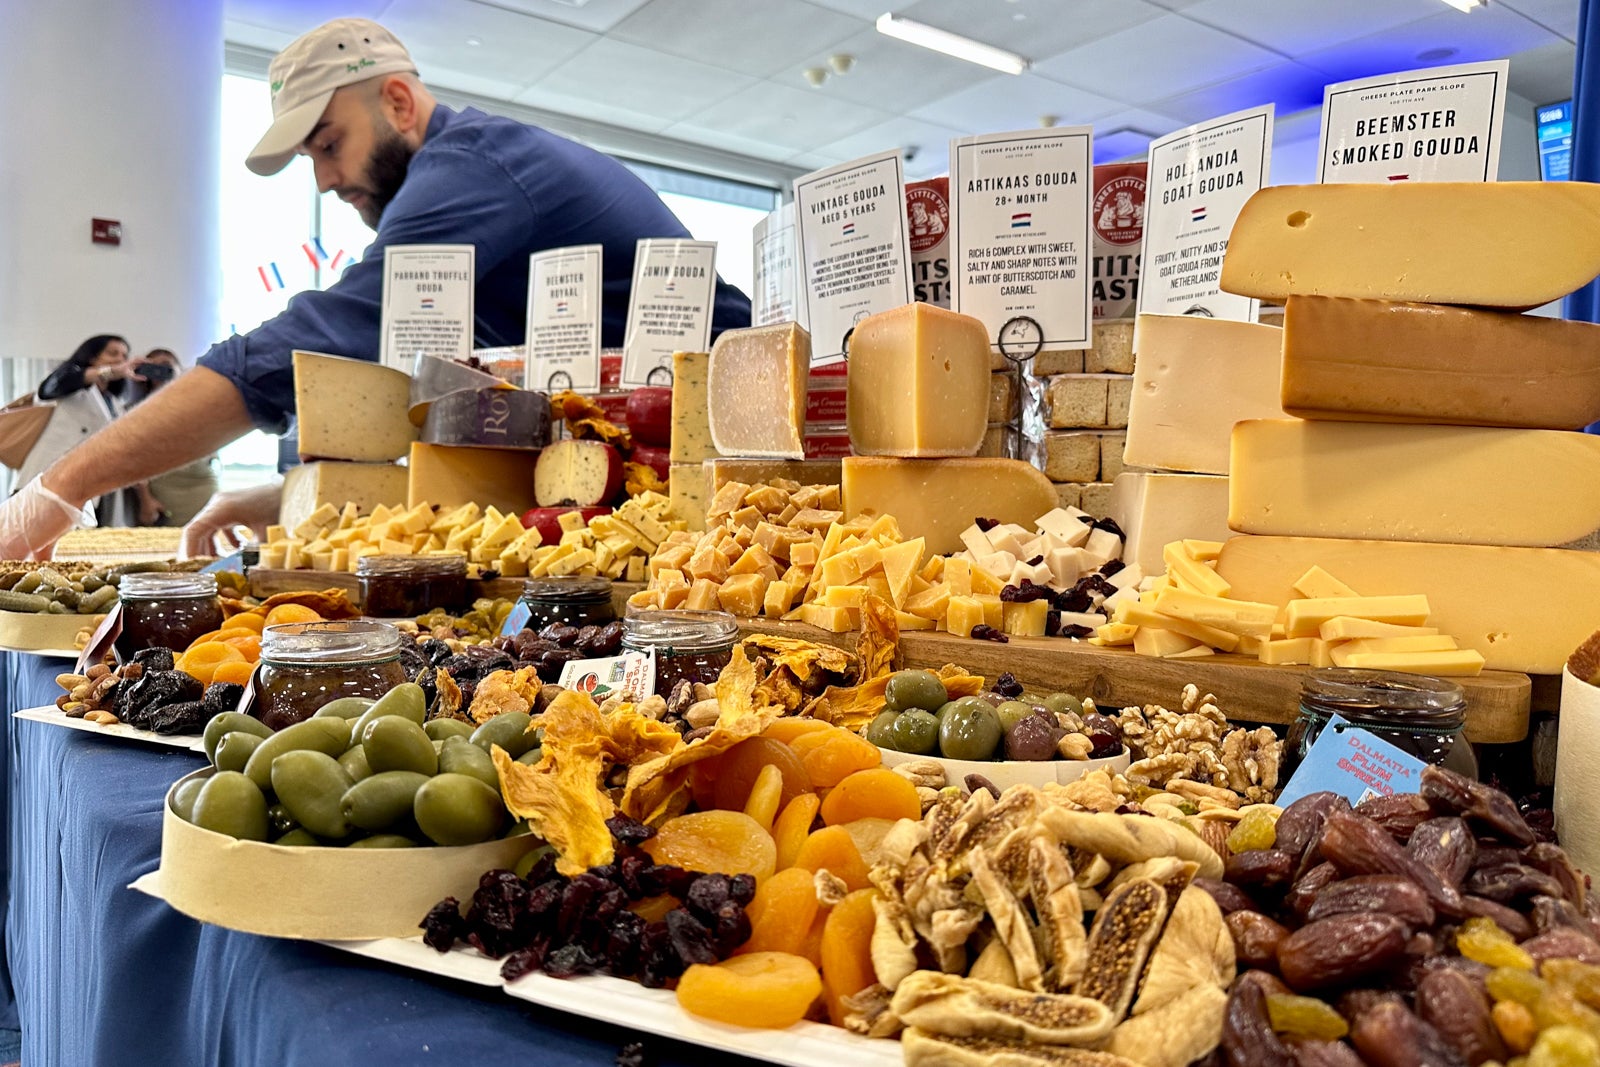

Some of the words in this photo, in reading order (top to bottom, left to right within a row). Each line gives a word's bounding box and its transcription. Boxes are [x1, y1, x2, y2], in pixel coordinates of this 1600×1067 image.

[1356, 110, 1456, 137] BEEMSTER
[1332, 142, 1404, 166] SMOKED
[1414, 136, 1478, 157] GOUDA
[1166, 149, 1238, 182] HOLANDIA
[968, 175, 1028, 193] ARTIKAAS
[1036, 172, 1077, 186] GOUDA
[1163, 184, 1192, 204] GOAT
[1200, 170, 1244, 194] GOUDA
[811, 194, 848, 214] VINTAGE
[853, 184, 885, 202] GOUDA
[910, 191, 936, 200] LITTLE
[995, 196, 1012, 206] 28+
[1016, 193, 1048, 204] MONTH
[1094, 185, 1113, 213] THREE
[1115, 180, 1145, 191] LITTLE
[822, 212, 840, 225] AGED
[843, 210, 847, 219] 5
[851, 202, 876, 217] YEARS
[876, 252, 890, 261] SWEET
[968, 248, 984, 258] RICH
[986, 248, 991, 257] &
[992, 245, 1026, 257] COMPLEX
[1028, 244, 1047, 254] WITH
[1048, 242, 1076, 253] SWEET,
[1181, 246, 1202, 259] NUTTY
[1203, 242, 1217, 254] AND
[674, 266, 705, 278] GOUDA
[967, 261, 989, 272] SALTY
[991, 260, 1006, 270] AND
[1007, 259, 1031, 269] SHARP
[1033, 257, 1056, 267] NOTES
[1058, 256, 1077, 266] WITH
[1160, 265, 1176, 278] GOAT
[1177, 260, 1198, 274] GOUDA
[1200, 256, 1220, 269] FROM
[434, 271, 468, 280] TRUFFLE
[969, 276, 974, 285] A
[975, 274, 991, 284] HINT
[992, 273, 1001, 283] OF
[1003, 270, 1058, 283] BUTTERSCOTCH
[1060, 269, 1076, 279] AND
[1170, 271, 1218, 289] NETHERLANDS
[417, 284, 443, 292] GOUDA
[1000, 285, 1037, 296] CARAMEL.
[633, 658, 641, 676] FIG
[623, 672, 633, 690] SPR
[638, 664, 648, 702] DALMAT
[1347, 736, 1410, 778] DALMATIA
[1351, 752, 1393, 782] PLUM
[1336, 757, 1394, 796] SPREAD
